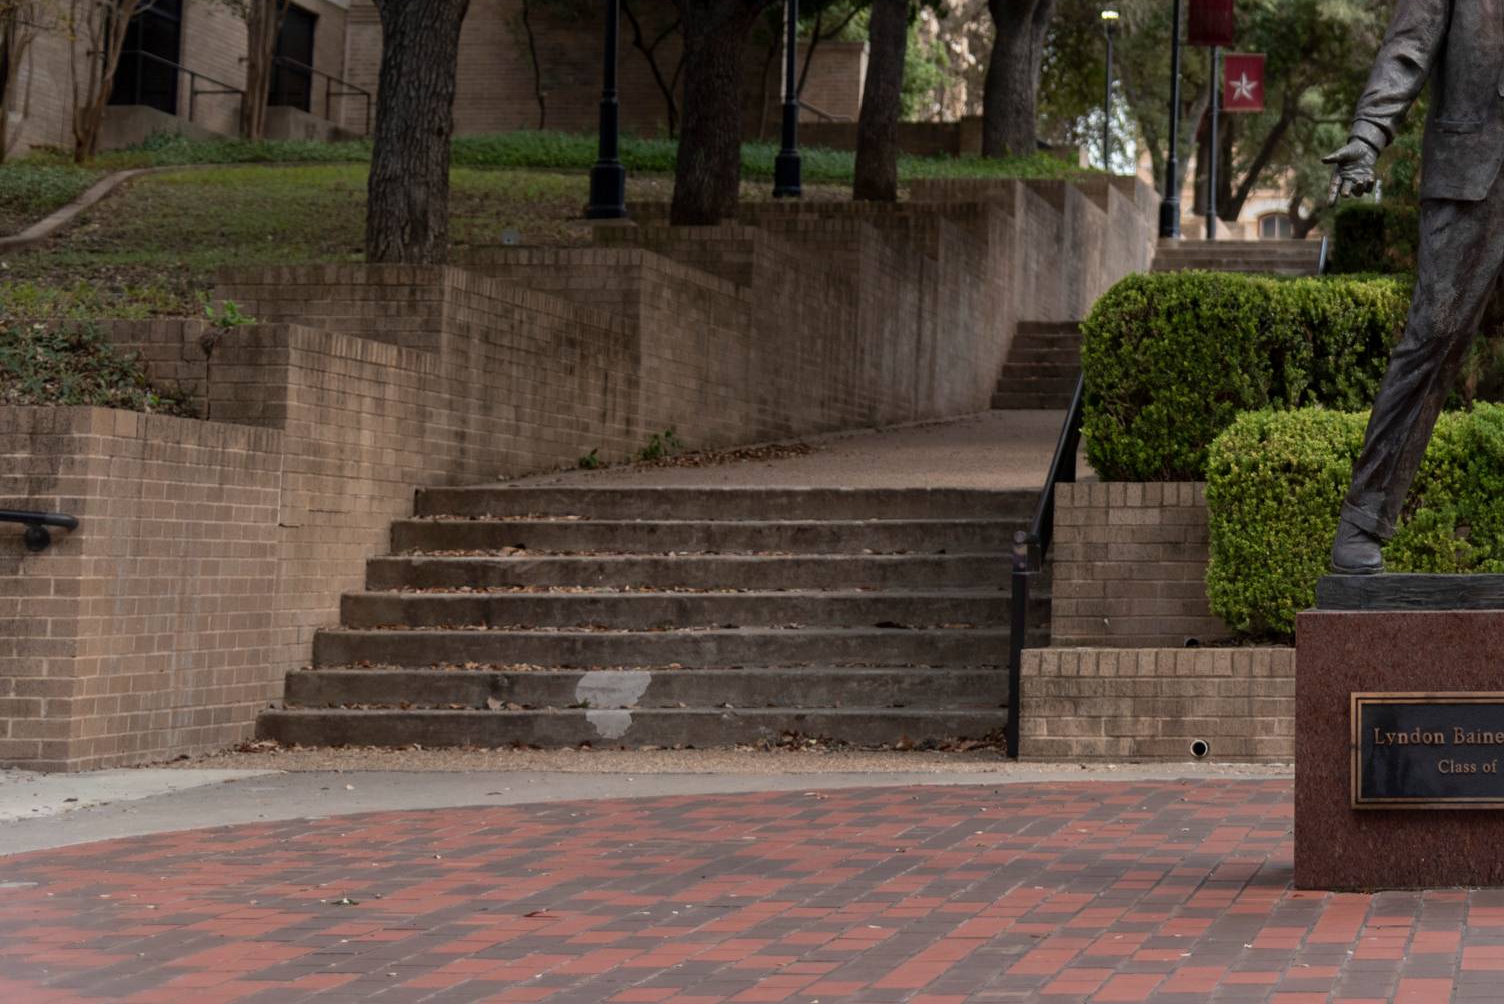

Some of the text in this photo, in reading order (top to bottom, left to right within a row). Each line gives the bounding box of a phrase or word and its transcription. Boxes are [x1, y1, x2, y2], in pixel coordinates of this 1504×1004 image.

[1374, 727, 1445, 746] Lyndon
[1438, 759, 1476, 774] Class
[1482, 759, 1497, 774] of
